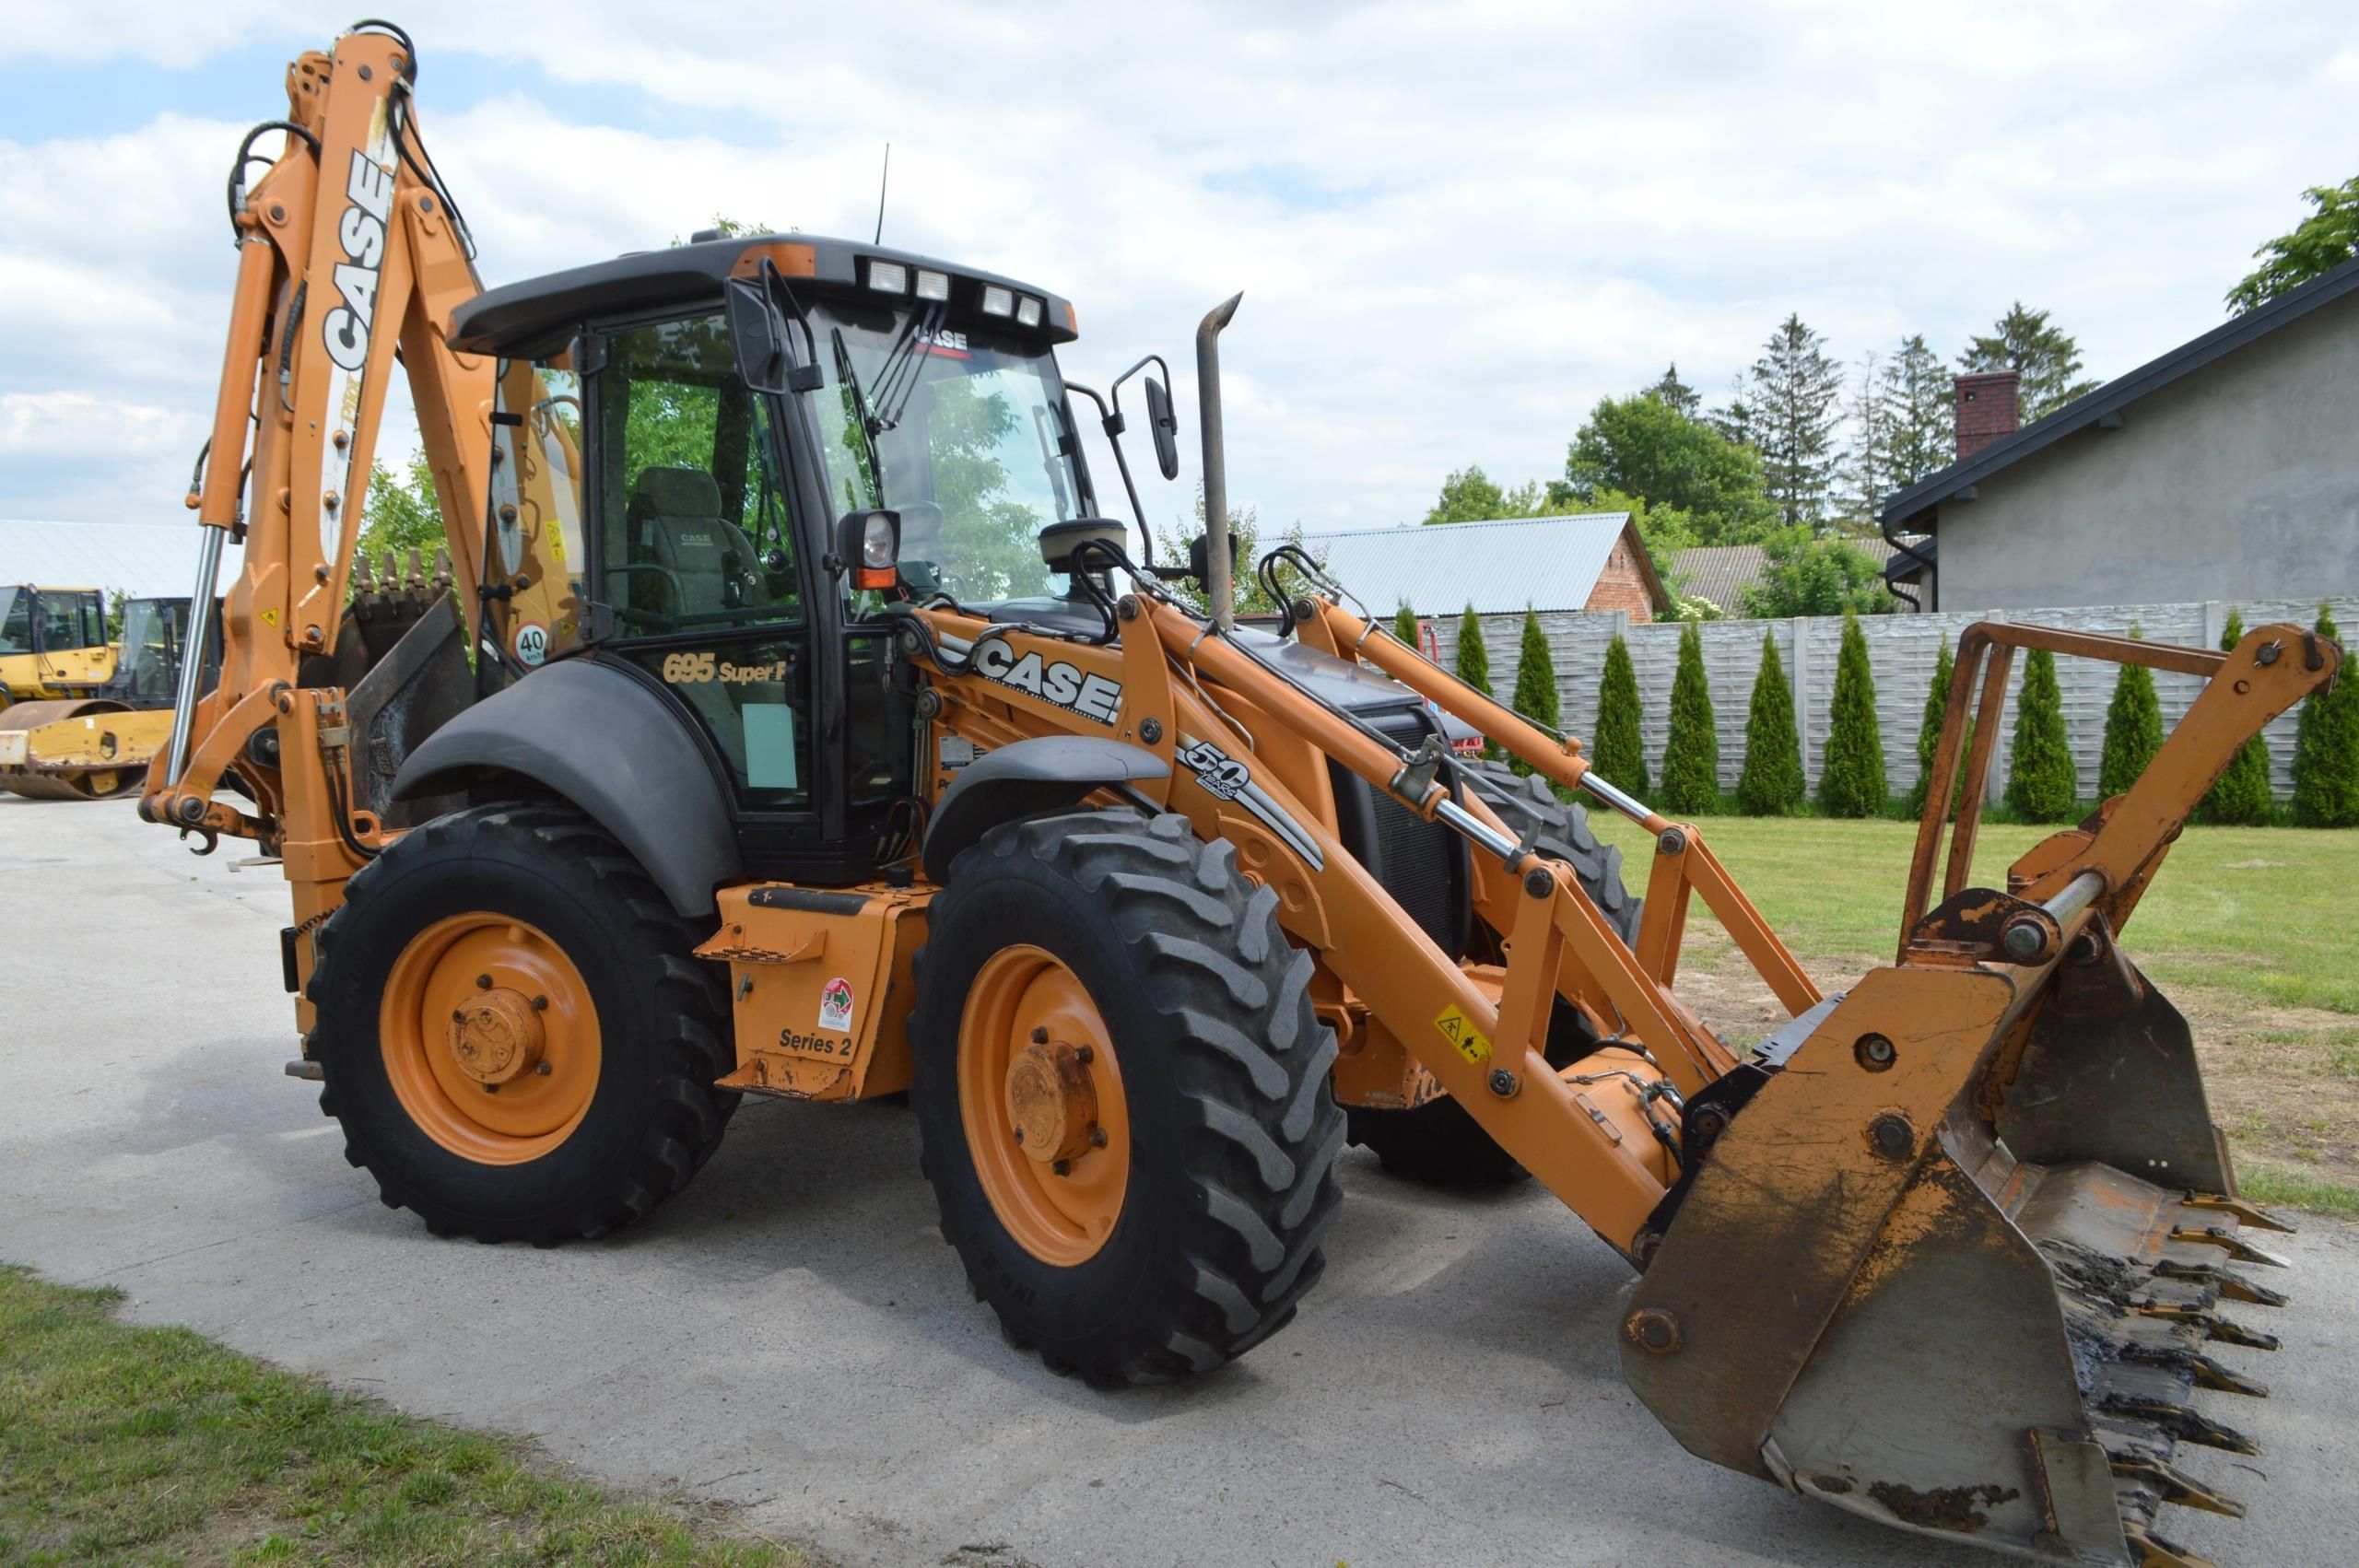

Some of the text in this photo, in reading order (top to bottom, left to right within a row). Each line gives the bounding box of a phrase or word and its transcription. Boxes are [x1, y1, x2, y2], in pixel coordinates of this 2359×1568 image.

[323, 147, 393, 371] CASE
[681, 533, 710, 542] CASE
[521, 631, 543, 651] 40
[663, 652, 715, 683] 695
[719, 661, 773, 685] Super
[973, 638, 1122, 720] CASE
[1185, 741, 1250, 789] 50
[1201, 770, 1238, 798] YEARS
[780, 1028, 852, 1056] Series 2
